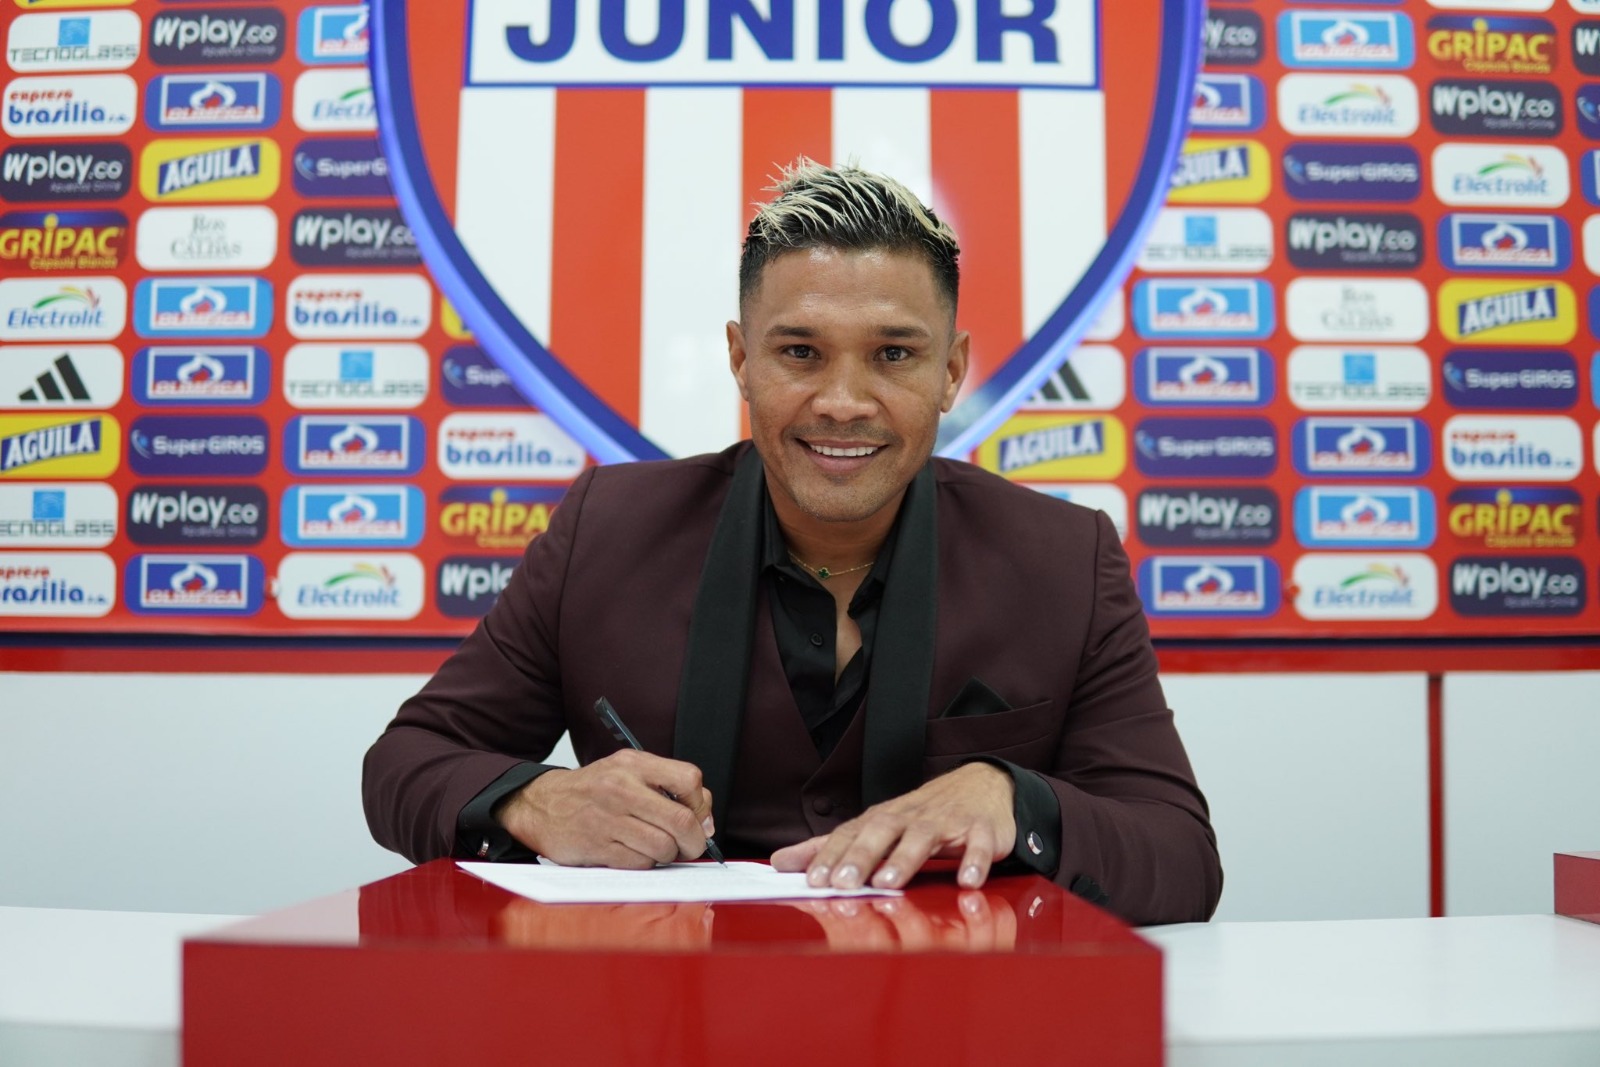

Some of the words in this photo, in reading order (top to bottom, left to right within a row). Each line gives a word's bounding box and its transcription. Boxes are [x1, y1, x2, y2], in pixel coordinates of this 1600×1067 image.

[154, 14, 277, 50] Wplay.co
[505, 0, 1061, 63] JUNIOR
[9, 99, 106, 126] brasilia
[1432, 85, 1555, 121] Wplay.co
[3, 150, 123, 185] Wplay.co
[162, 145, 255, 194] AGUILA
[1289, 218, 1416, 253] Wplay.co
[7, 308, 104, 329] Electrolit
[294, 302, 399, 325] brasilia
[1461, 286, 1552, 333] AGUILA
[4, 419, 95, 471] AGUILA
[152, 434, 266, 458] SuperGIROS
[446, 442, 553, 466] brasilia
[1003, 423, 1099, 471] AGUILA
[1450, 443, 1553, 468] brasilia
[131, 491, 259, 528] Wplay.co
[1140, 493, 1272, 530] Wplay.co
[297, 583, 401, 608] Electrolit
[1453, 563, 1579, 600] Wplay.co
